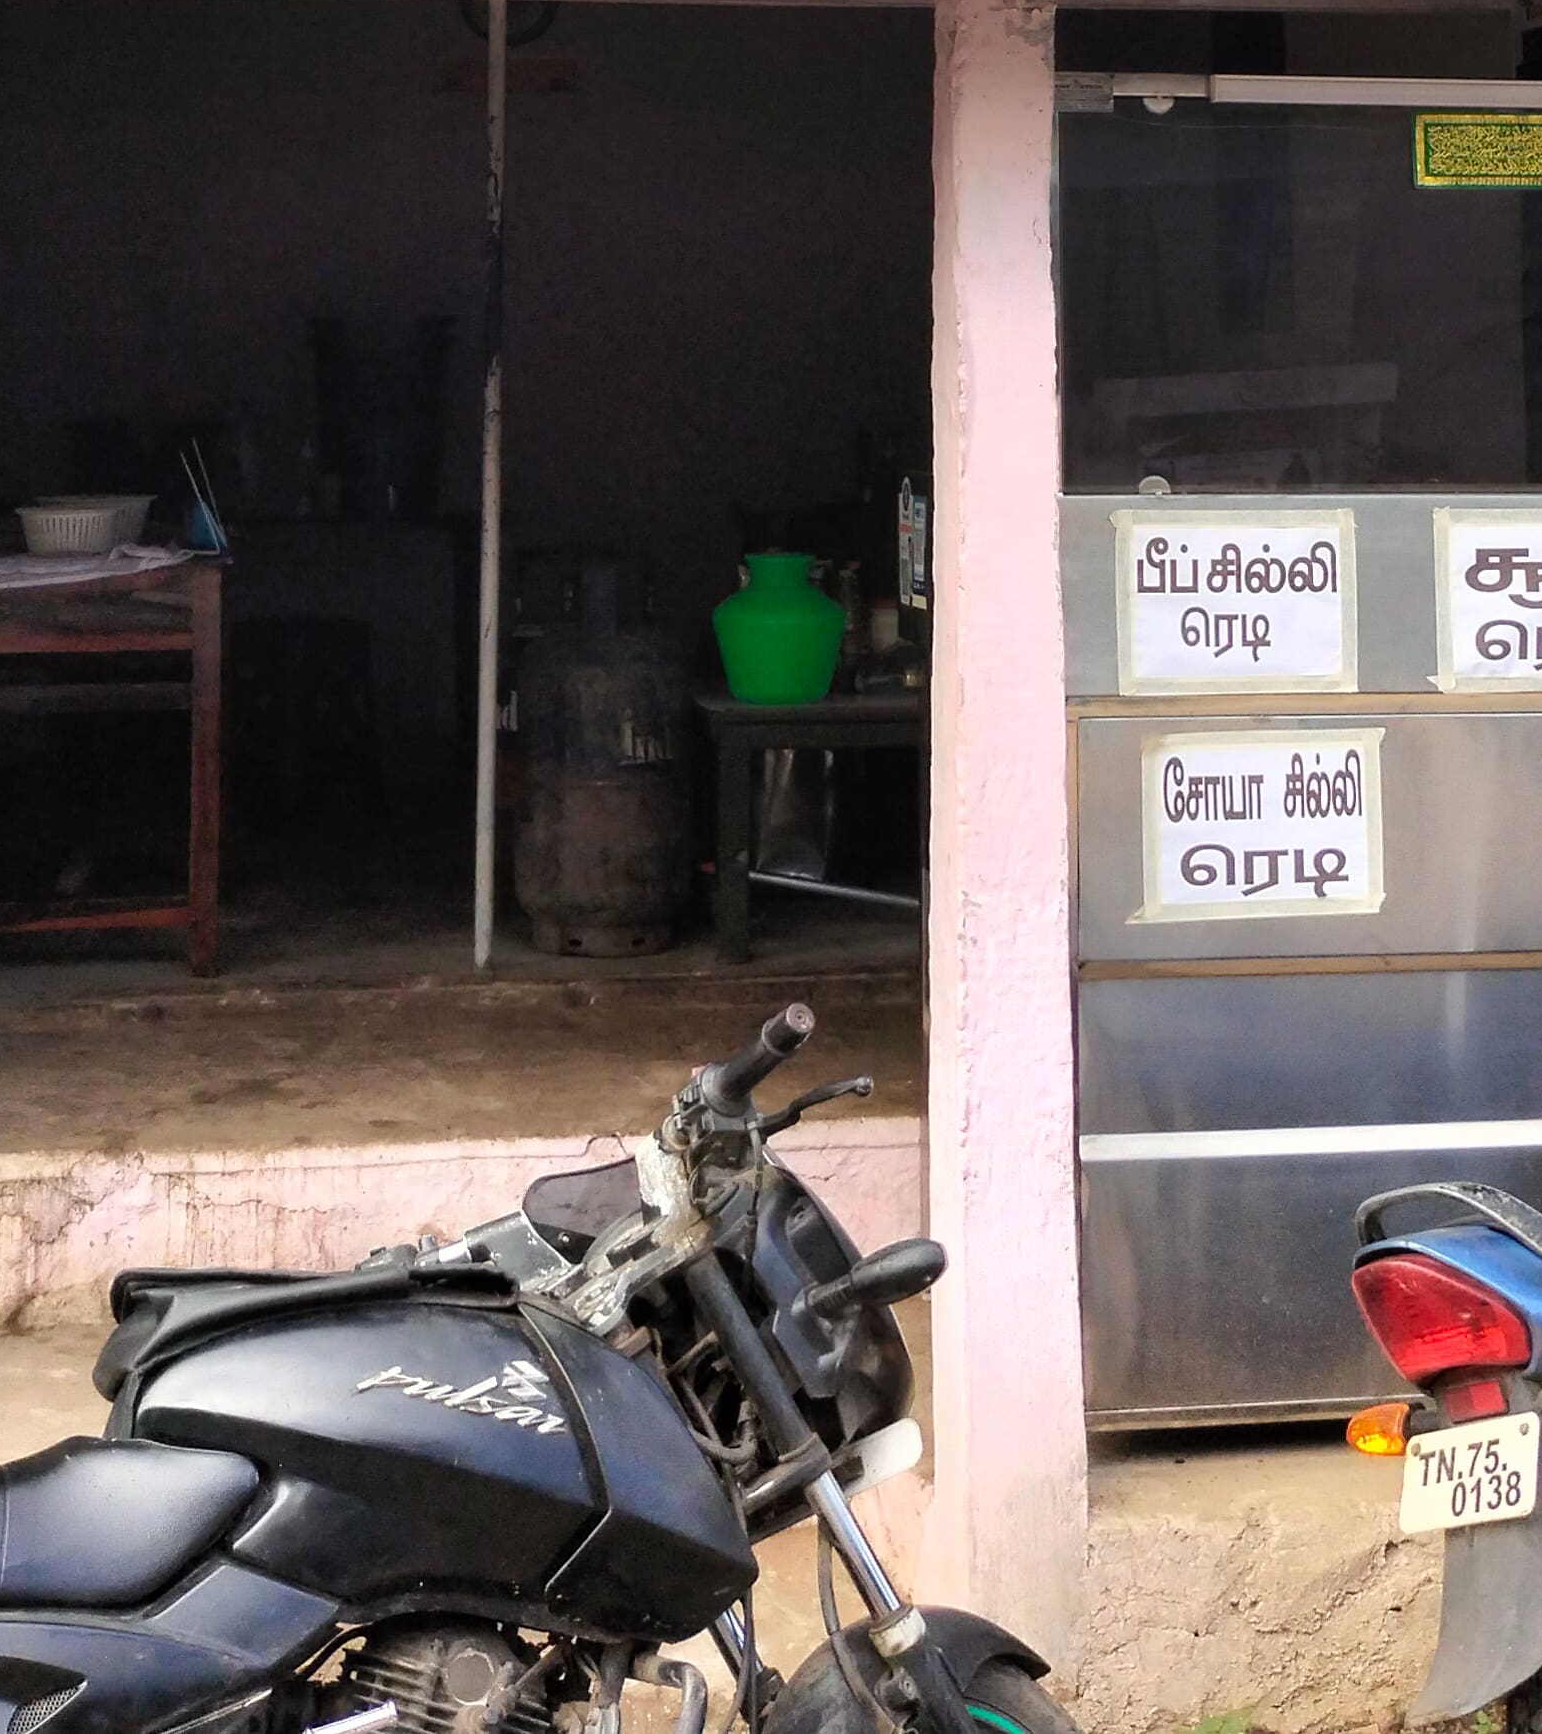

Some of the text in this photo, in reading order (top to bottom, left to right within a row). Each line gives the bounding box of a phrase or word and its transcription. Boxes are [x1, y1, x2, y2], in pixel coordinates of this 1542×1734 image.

[1180, 606, 1271, 663] ரெடி
[1162, 747, 1363, 824] சோயா சில்லி
[1180, 842, 1351, 898] ரெடி
[1451, 1470, 1522, 1518] 0138
